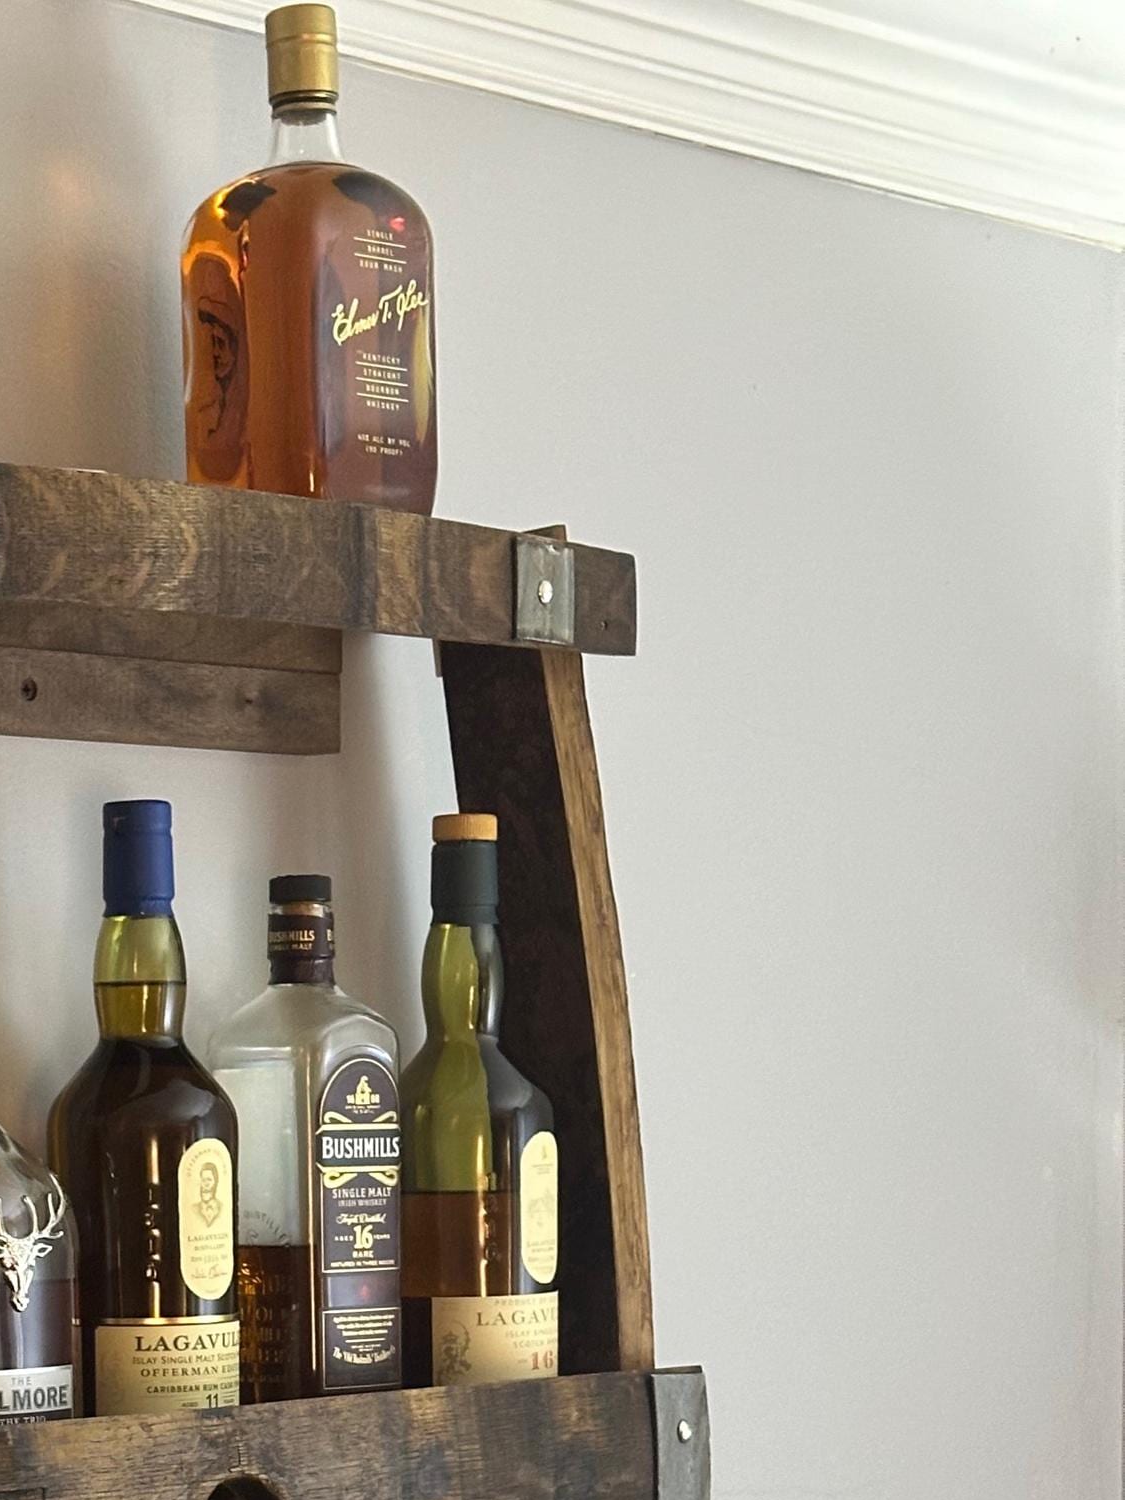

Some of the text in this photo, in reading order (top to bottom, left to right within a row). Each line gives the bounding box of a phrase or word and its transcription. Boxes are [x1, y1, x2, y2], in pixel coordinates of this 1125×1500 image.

[366, 229, 394, 241] SINGLE
[367, 245, 395, 257] BARREL
[359, 259, 403, 273] SOUR MASH
[362, 351, 401, 365] KENTUCKY
[363, 367, 401, 379] STRAIGHT
[365, 383, 400, 396] BOURBON
[366, 399, 400, 412] WHISKEY
[322, 1136, 400, 1159] BUSHMILLS
[332, 1187, 392, 1199] SINGLE MALT
[353, 1224, 373, 1249] 16
[132, 1353, 215, 1365] ISLAY SINGLE MALT
[531, 1350, 554, 1370] 16
[140, 1366, 219, 1378] OFFERMAN
[11, 1376, 32, 1386] THE
[146, 1382, 219, 1394] CARIBBEAN RUM
[205, 1393, 219, 1408] 11
